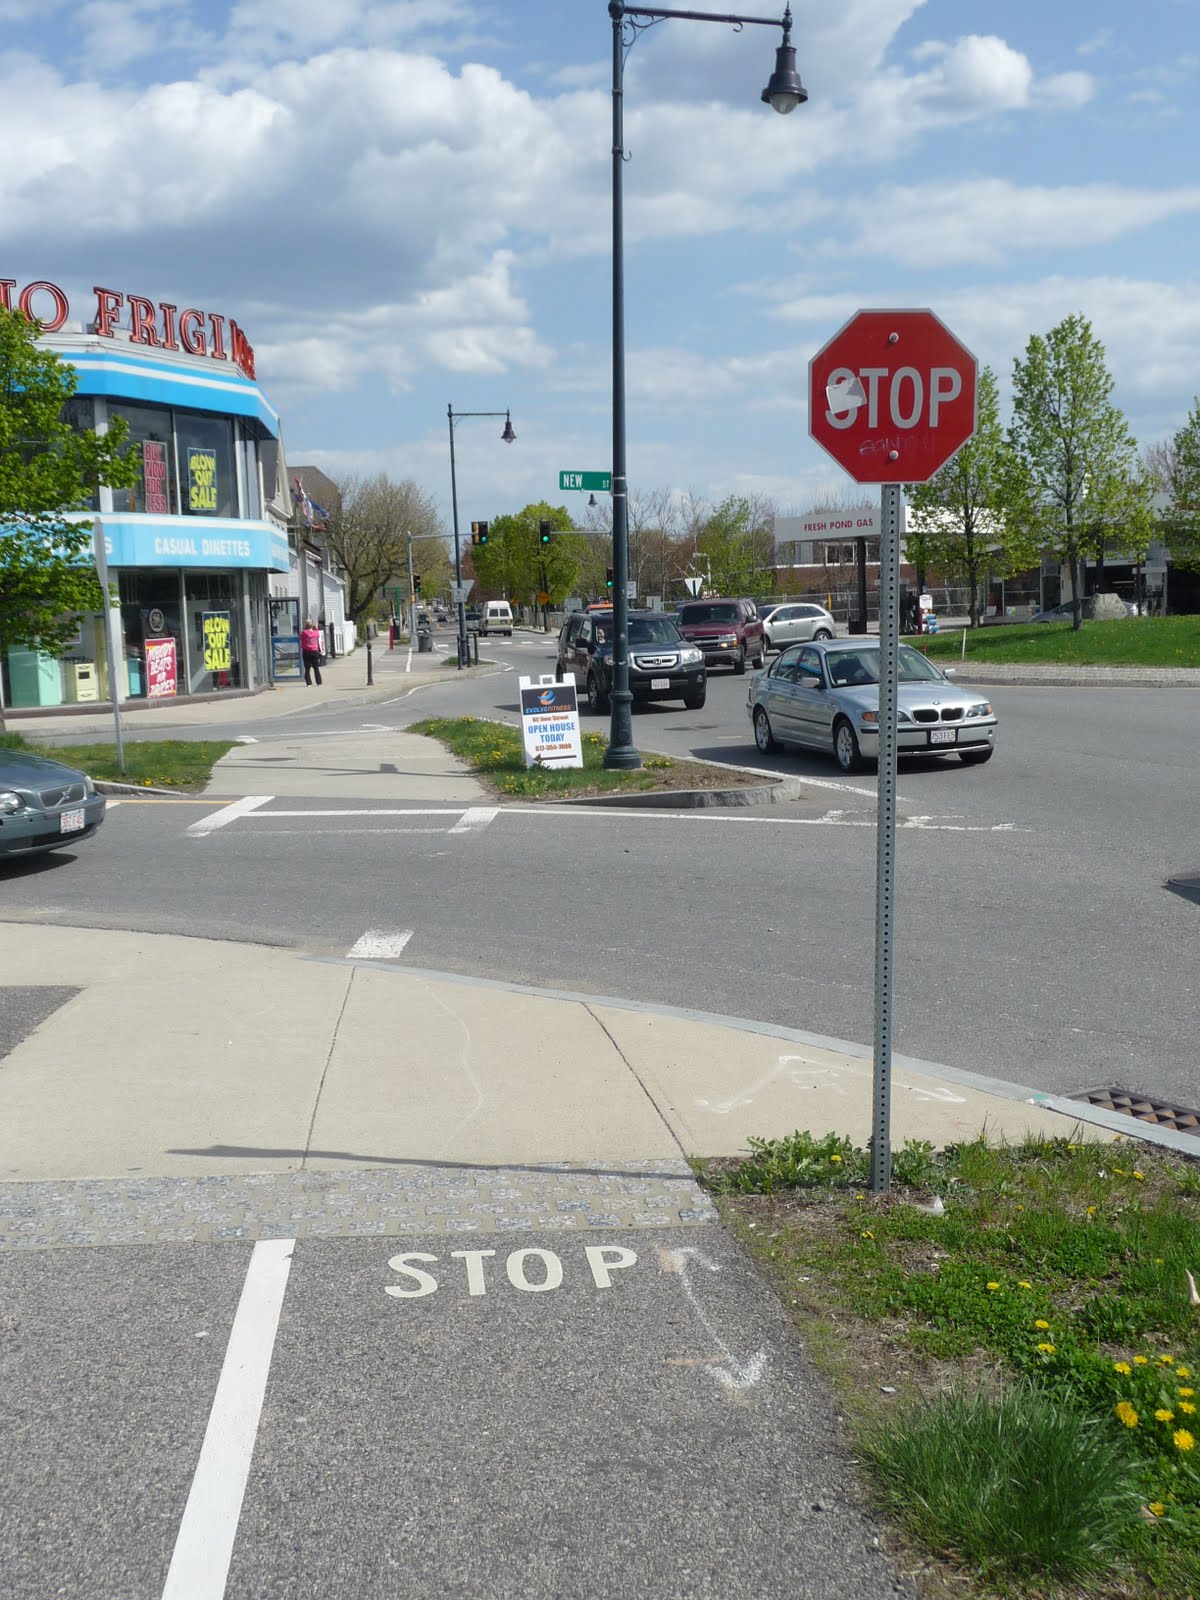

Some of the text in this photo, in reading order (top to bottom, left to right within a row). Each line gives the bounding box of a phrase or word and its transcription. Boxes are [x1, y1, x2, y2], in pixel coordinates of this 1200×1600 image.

[825, 366, 962, 429] STOP
[190, 453, 215, 471] BLOW
[563, 473, 610, 488] NEW ST
[146, 494, 166, 513] LESS
[190, 486, 217, 508] SALE
[804, 518, 873, 532] FRESH POND GAS
[155, 537, 197, 556] CASUAL
[201, 538, 250, 557] DINETTES
[204, 616, 229, 633] BLOW
[207, 632, 227, 648] OUT
[150, 656, 172, 676] BEATS
[204, 648, 230, 670] SALE
[528, 722, 575, 734] OPEN HOUSE
[540, 733, 565, 743] TODAY
[384, 1245, 638, 1298] STOP
